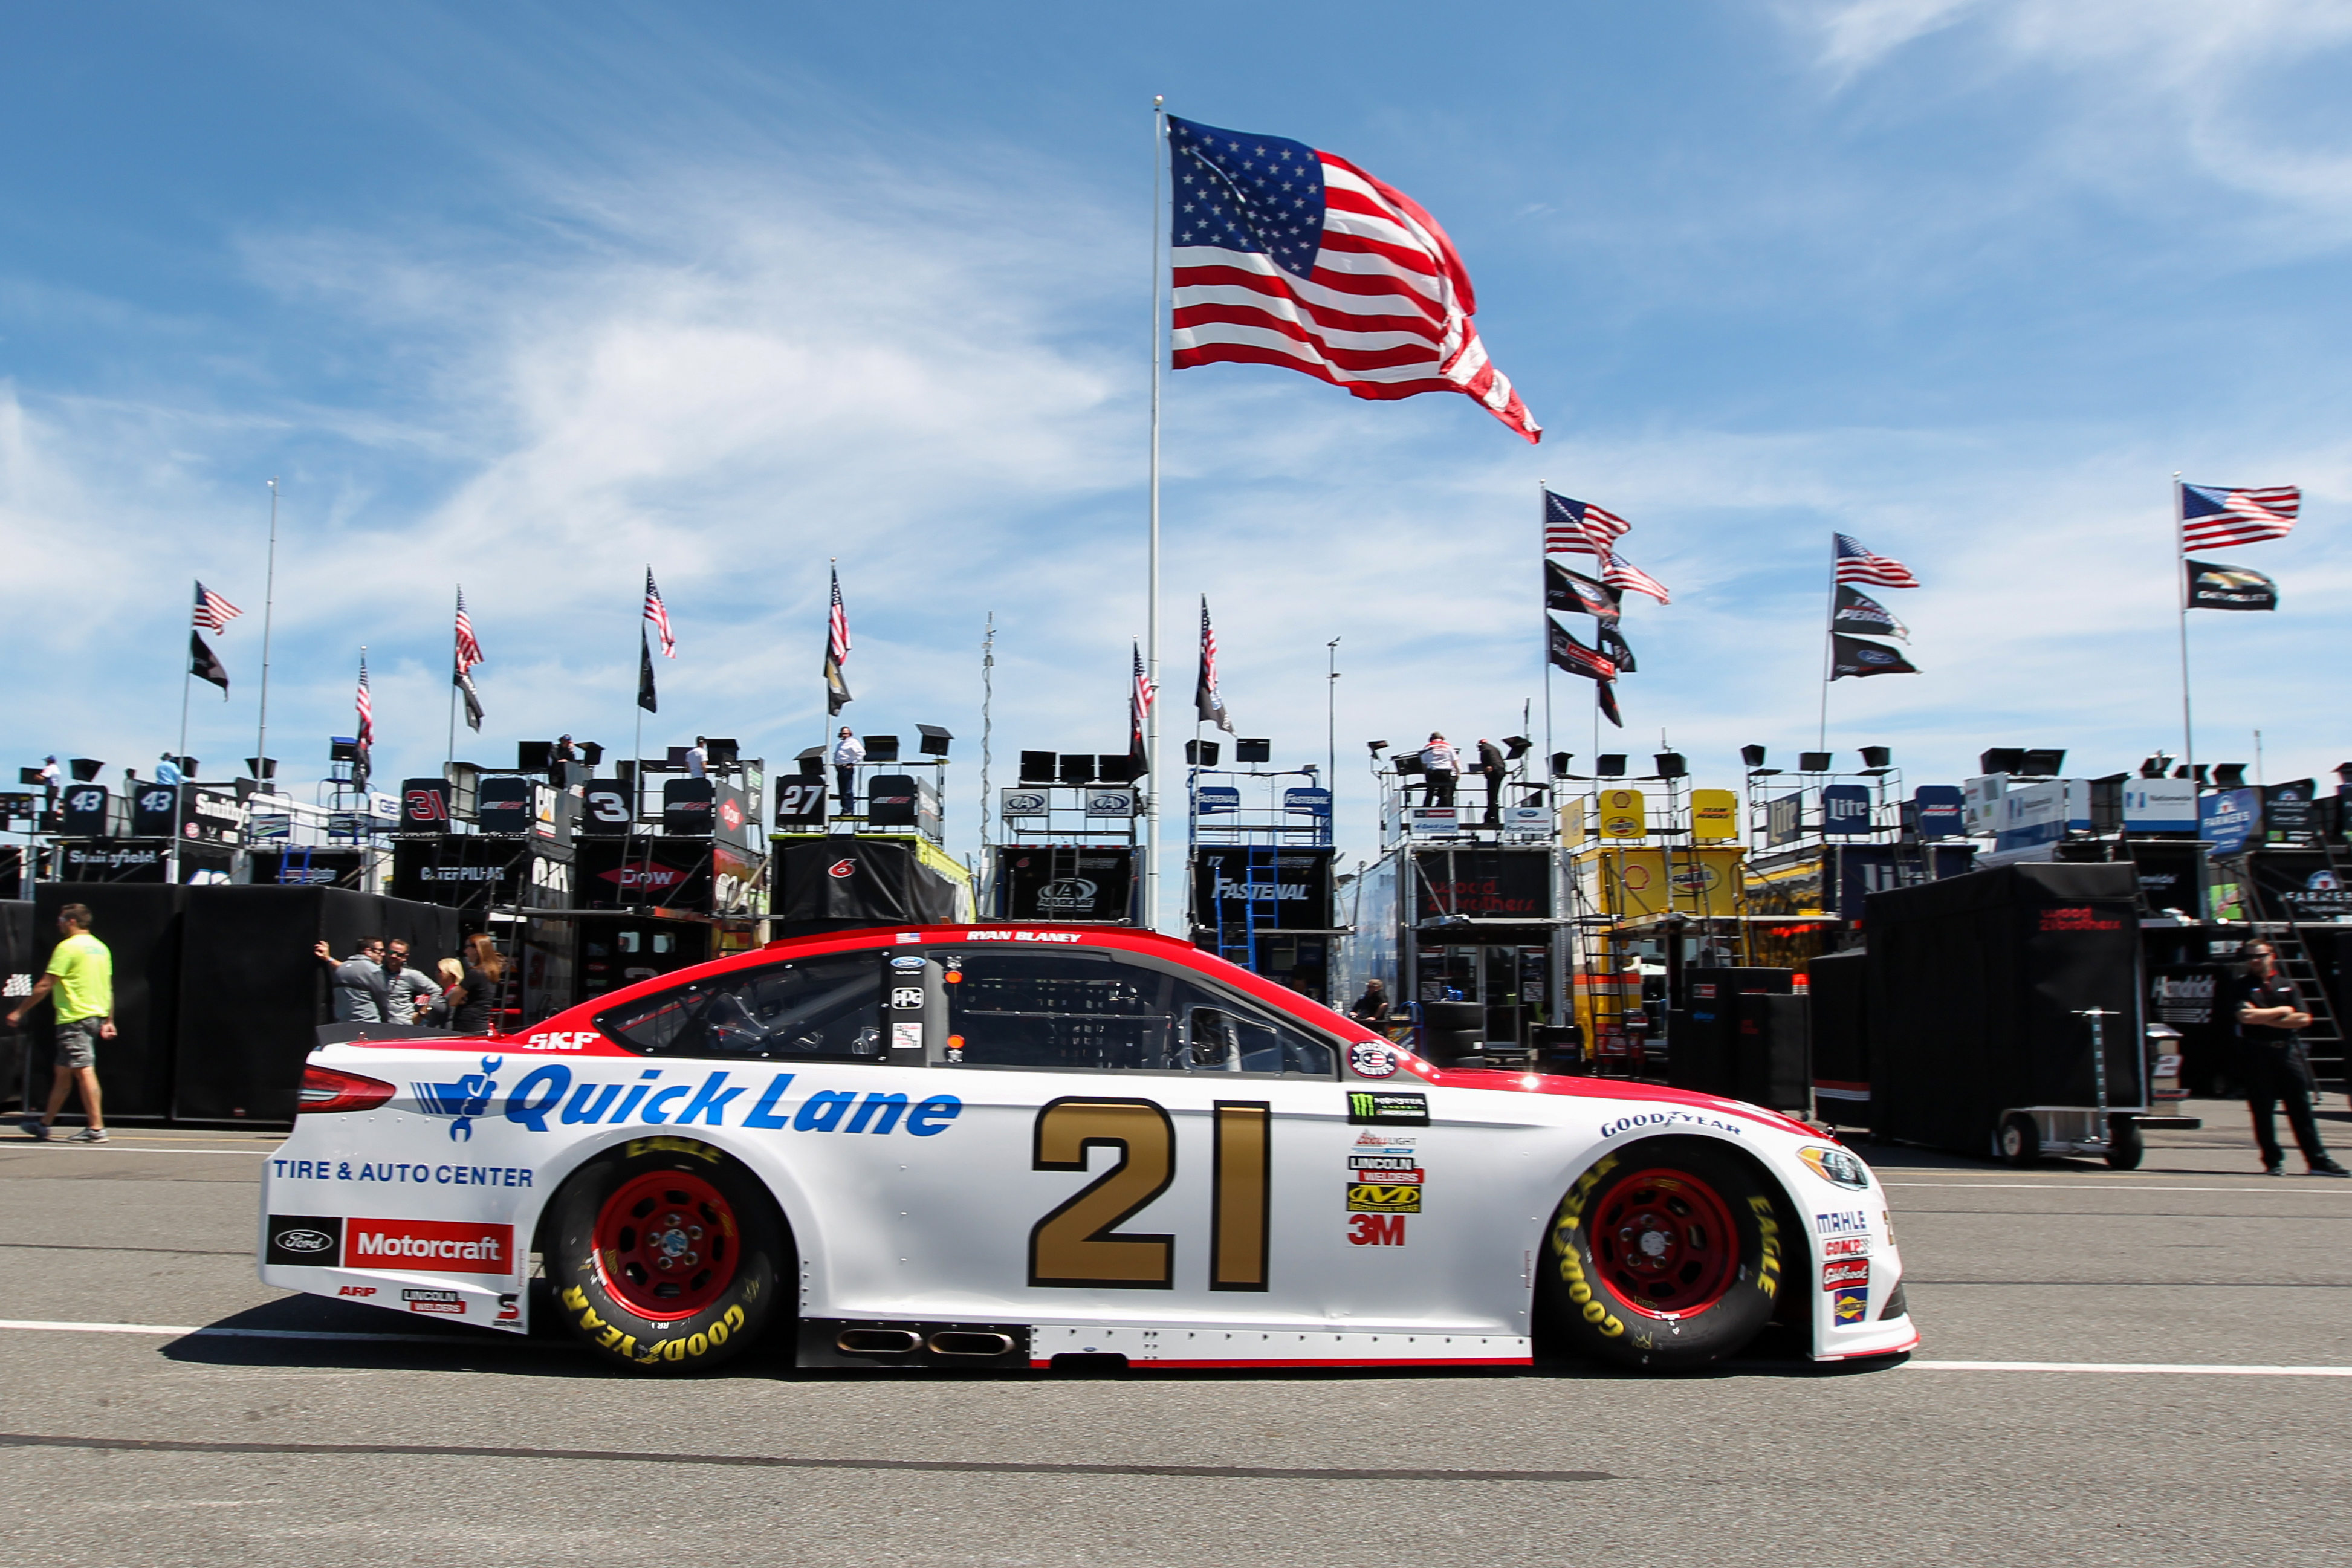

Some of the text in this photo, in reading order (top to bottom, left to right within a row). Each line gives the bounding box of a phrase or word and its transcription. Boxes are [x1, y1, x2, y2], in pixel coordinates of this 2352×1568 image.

[70, 791, 103, 811] 43
[140, 791, 173, 811] 43
[405, 789, 448, 821] 31
[588, 792, 630, 822] 3
[779, 785, 824, 815] 27
[1286, 794, 1330, 804] FASTENAL
[1829, 798, 1868, 821] Lite
[2203, 811, 2250, 827] FARMERS
[828, 858, 857, 878] 6
[966, 931, 1082, 943] RYAN BLANEY
[893, 989, 922, 1008] PPG
[522, 1032, 601, 1050] SKF
[504, 1063, 962, 1138] Quick Lane
[1374, 1097, 1425, 1106] MONSTER
[273, 1159, 534, 1187] TIRE & AUTO CENTER
[1350, 1157, 1413, 1170] LINCOLN
[1363, 1171, 1419, 1182] WELDERS
[1026, 1095, 1271, 1292] 21
[1346, 1214, 1406, 1246] 3M
[1816, 1210, 1868, 1234] MAHLE
[284, 1230, 322, 1250] Ford
[357, 1231, 501, 1261] Motorcraft
[1824, 1265, 1868, 1285] Edelbrock
[338, 1285, 377, 1297] ARP
[403, 1290, 457, 1301] LINCOLN
[413, 1301, 462, 1313] WELDERS
